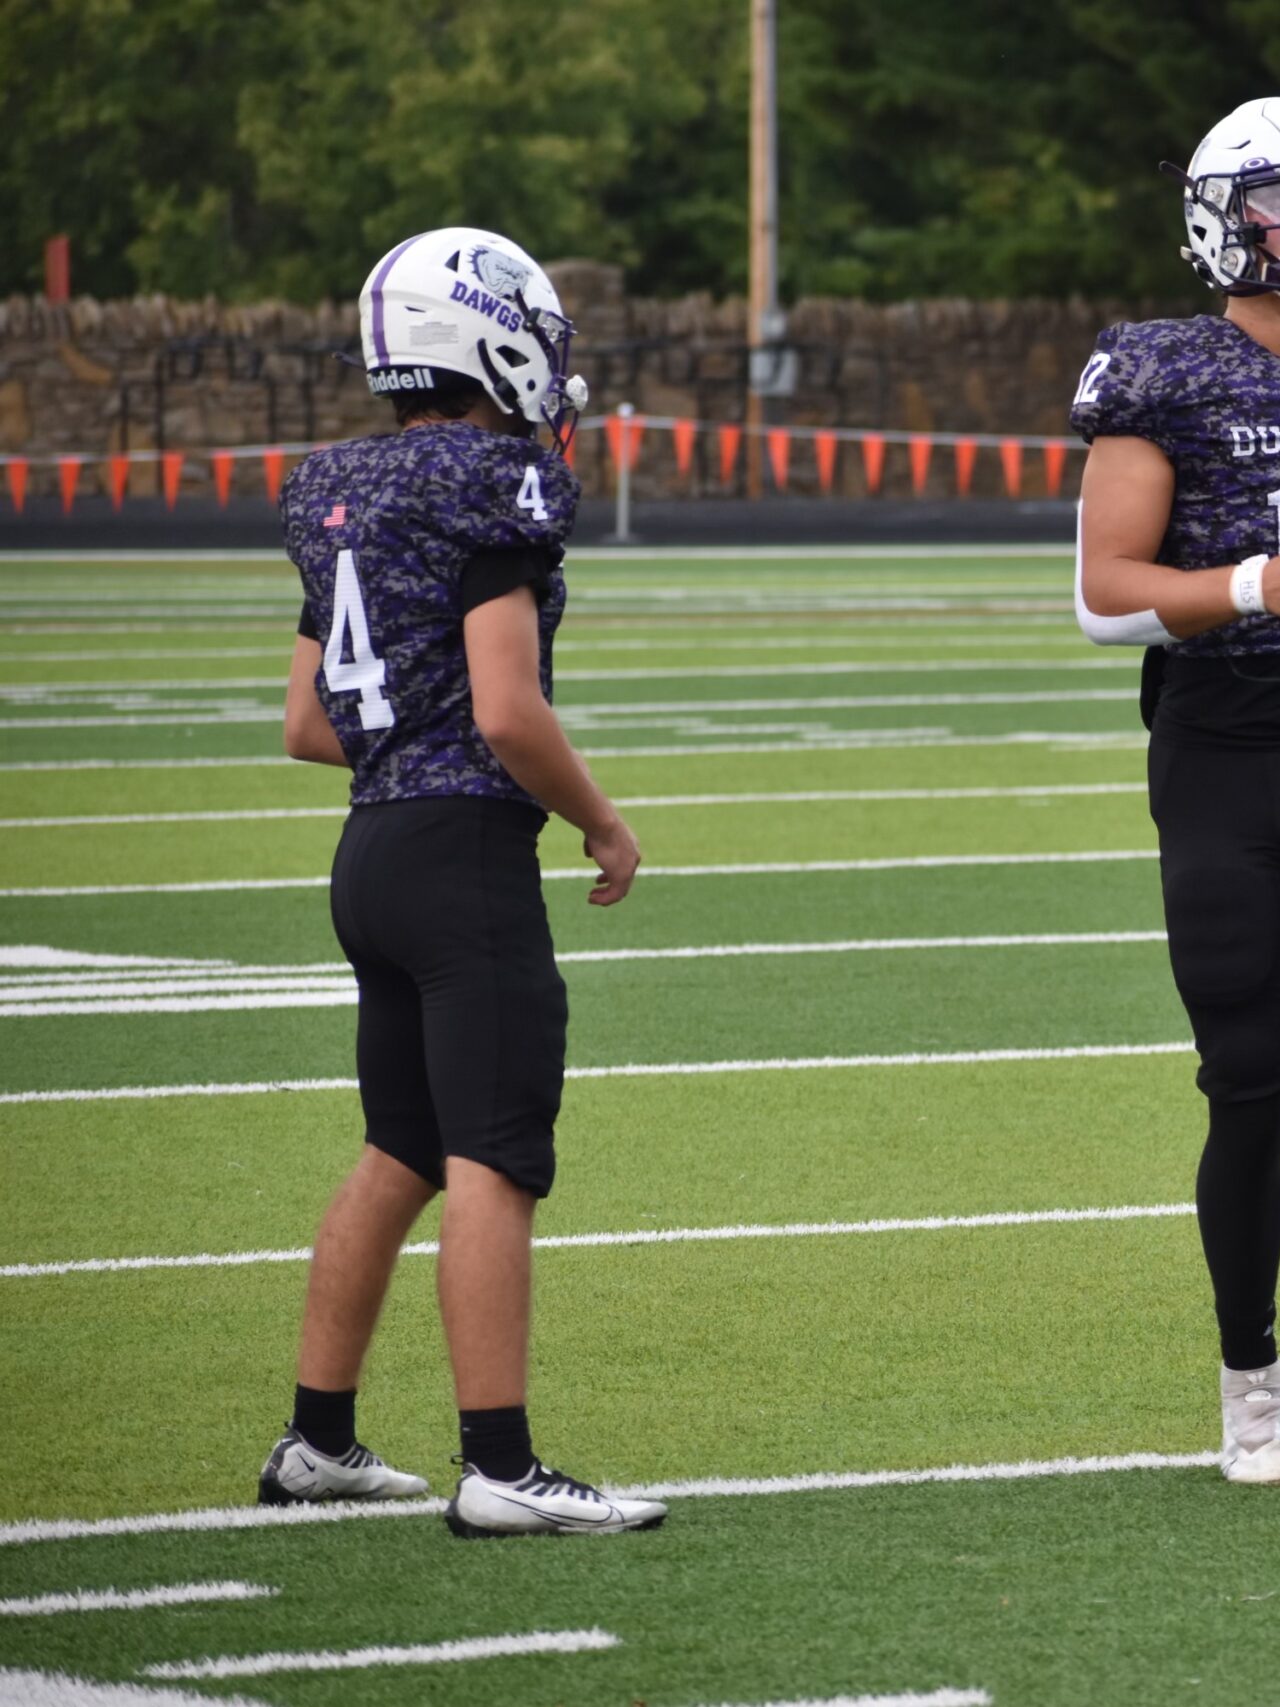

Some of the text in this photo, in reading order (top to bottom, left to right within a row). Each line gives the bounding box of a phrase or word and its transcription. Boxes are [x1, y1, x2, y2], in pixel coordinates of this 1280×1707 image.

[450, 280, 522, 333] DAWGS
[516, 466, 548, 520] 4
[323, 549, 395, 730] 4
